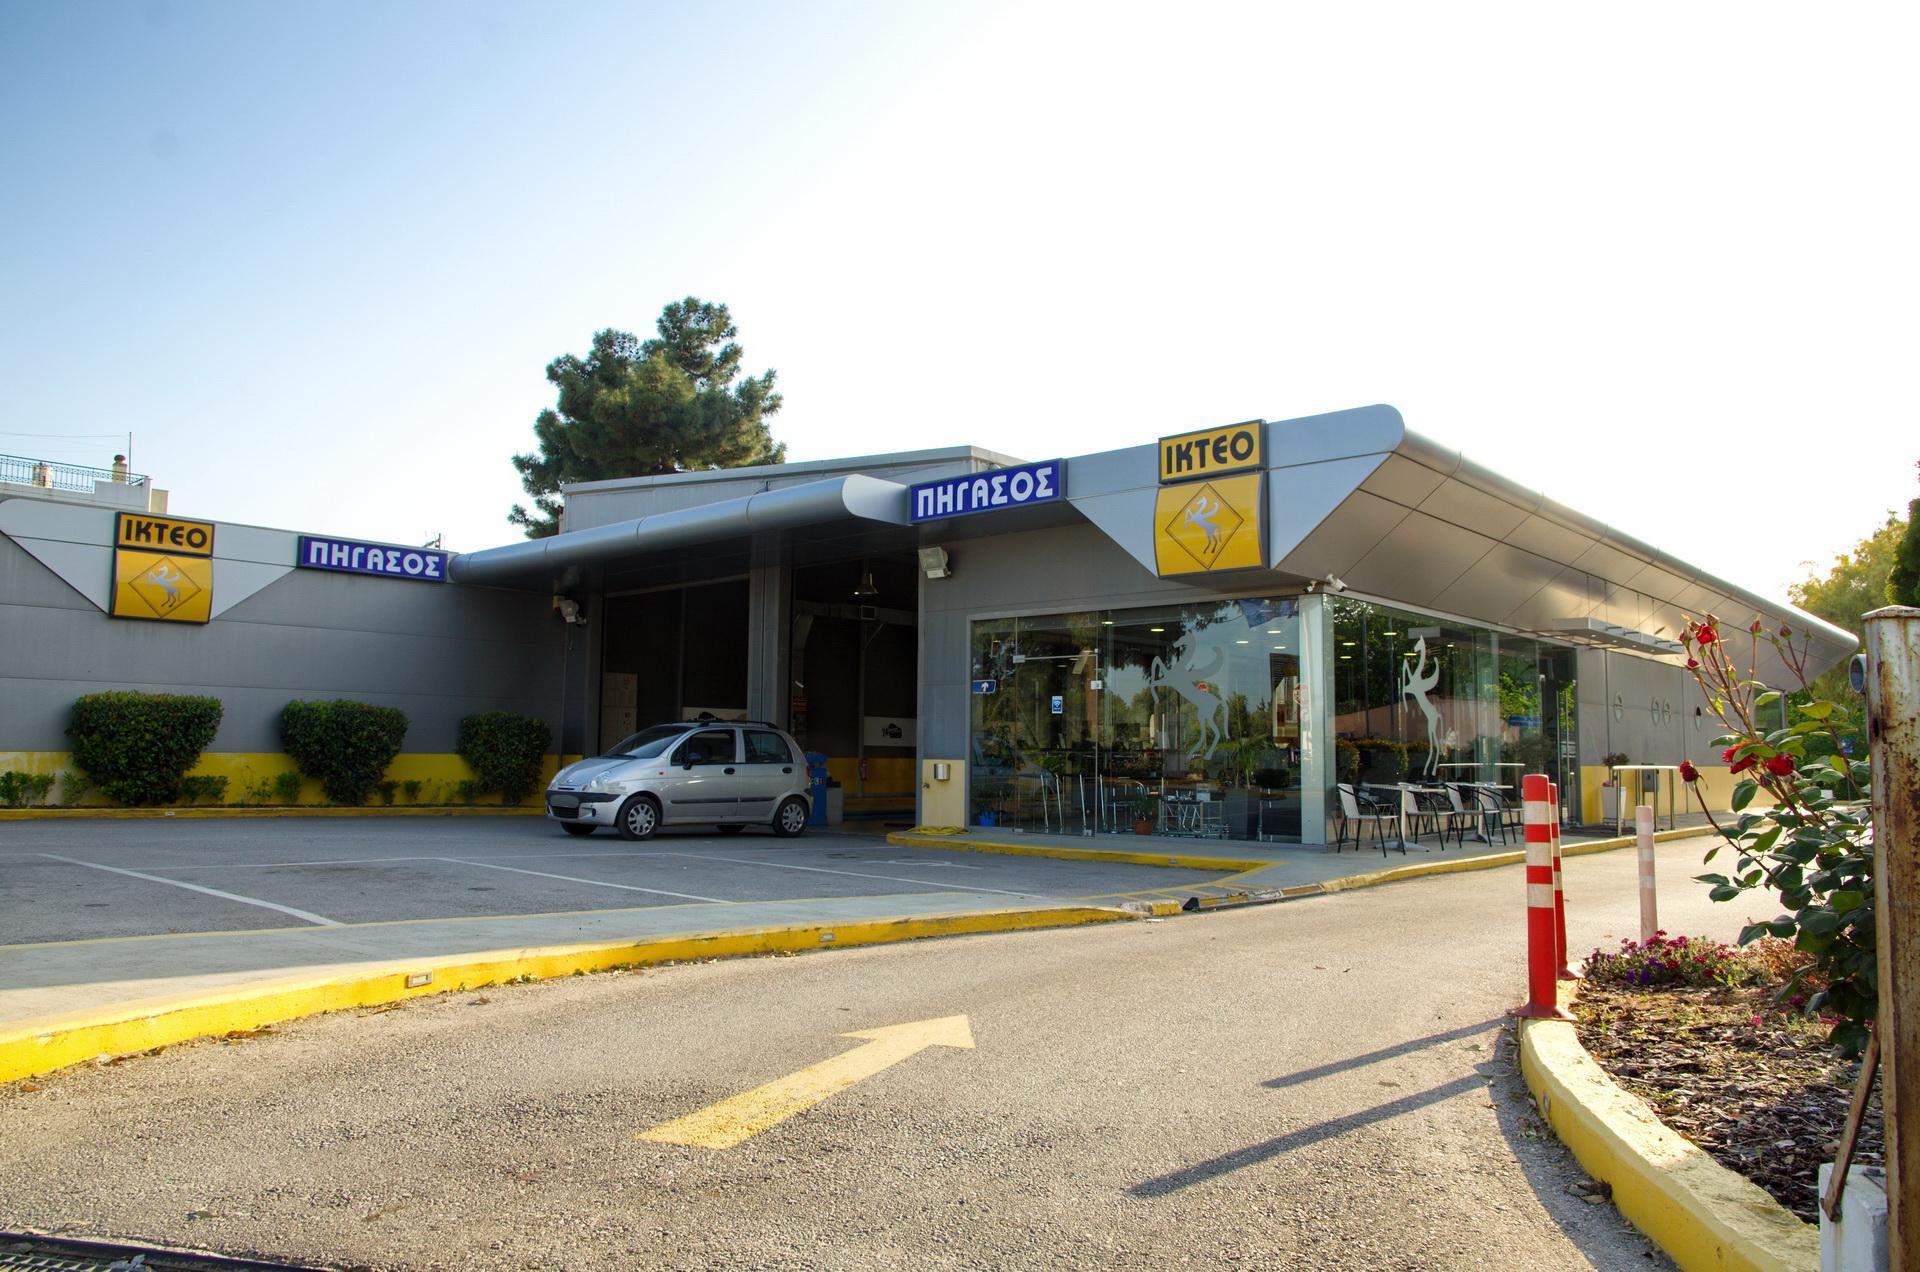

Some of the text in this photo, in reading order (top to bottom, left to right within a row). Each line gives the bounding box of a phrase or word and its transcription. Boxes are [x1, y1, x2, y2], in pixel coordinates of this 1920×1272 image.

[1166, 430, 1254, 474] ΙΚΤΕΟ
[917, 466, 1054, 517] ΠΗΓΑΣΟΣ
[125, 518, 208, 549] ΙΚΤΕΟ
[310, 541, 440, 577] ΠΗΓΑΣΟΣ
